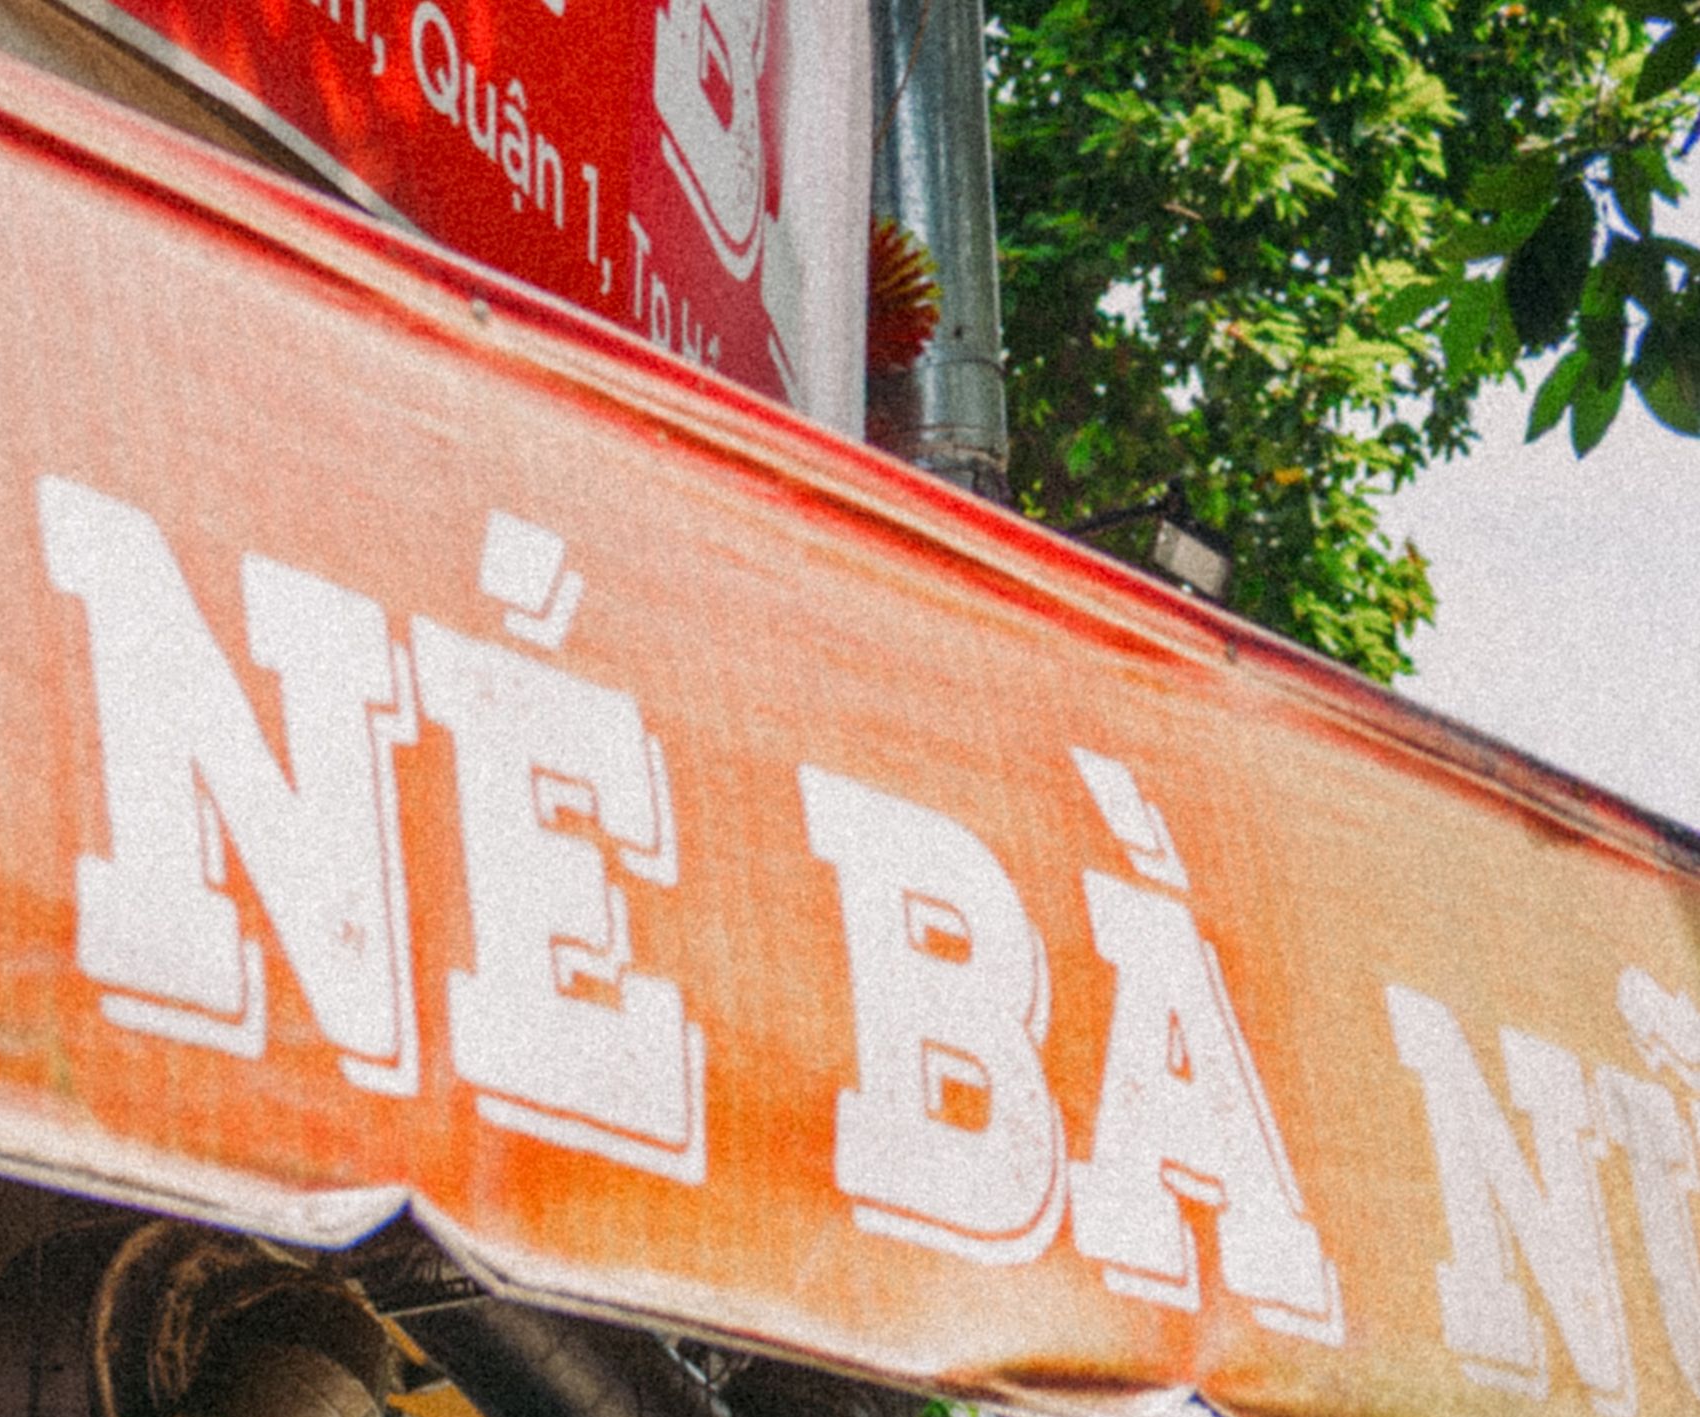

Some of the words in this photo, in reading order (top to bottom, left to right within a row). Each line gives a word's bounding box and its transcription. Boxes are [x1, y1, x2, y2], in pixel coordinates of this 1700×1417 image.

[411, 0, 564, 230] Quận
[581, 162, 613, 296] 1,
[35, 473, 707, 1187] NÉ
[797, 745, 1345, 1347] BÀ
